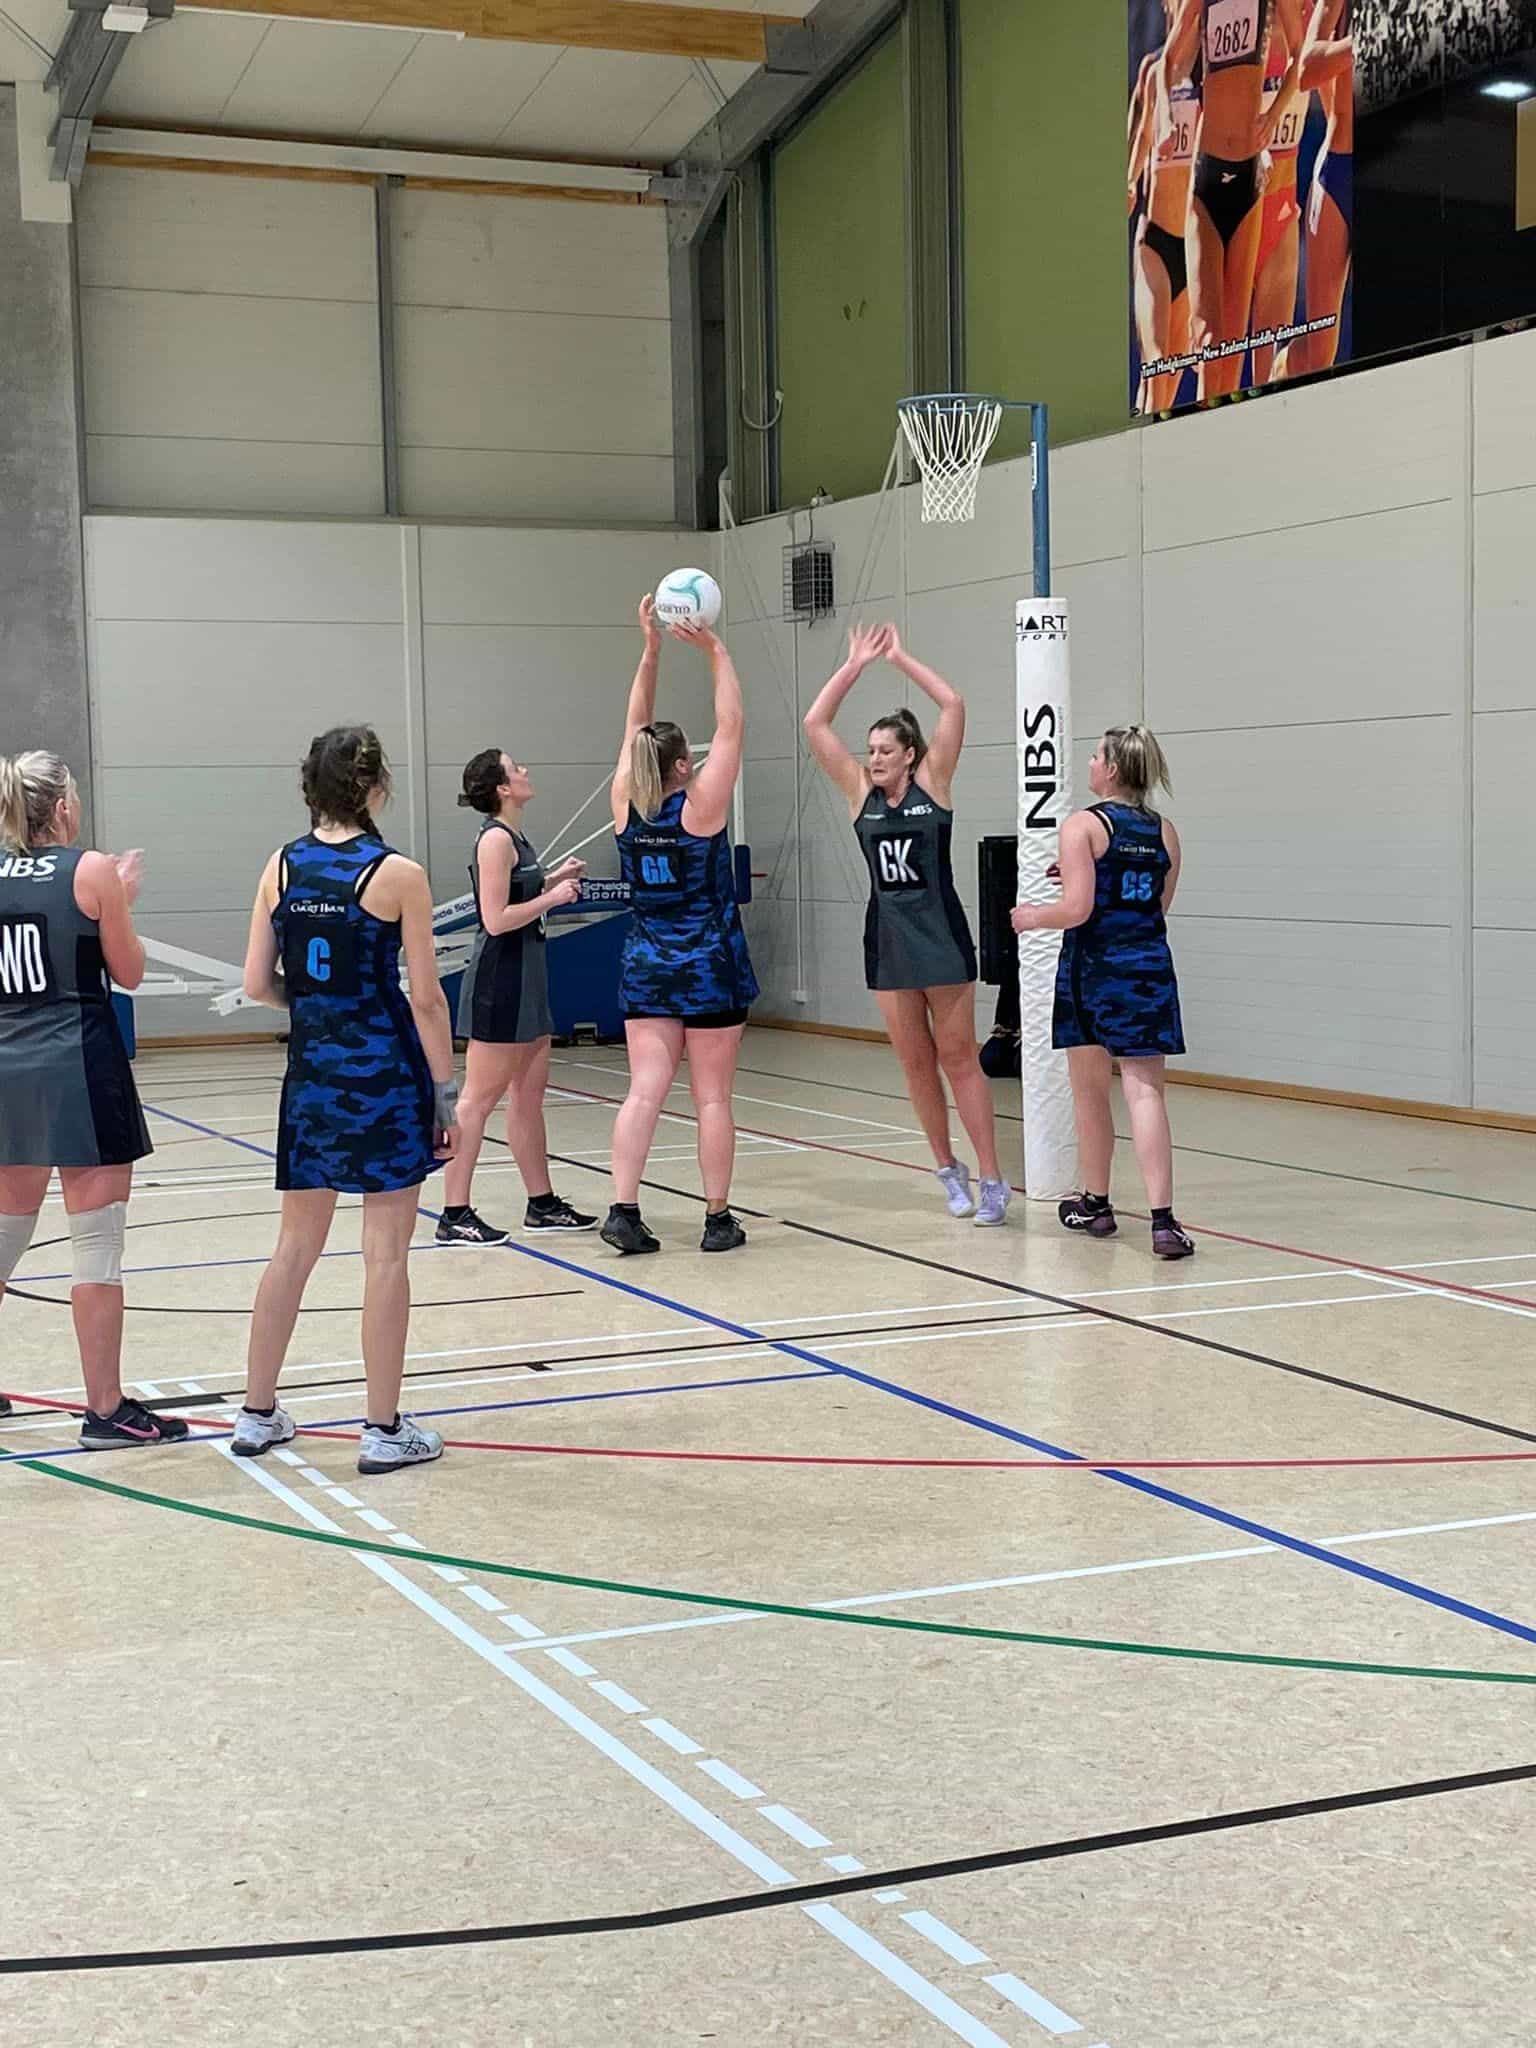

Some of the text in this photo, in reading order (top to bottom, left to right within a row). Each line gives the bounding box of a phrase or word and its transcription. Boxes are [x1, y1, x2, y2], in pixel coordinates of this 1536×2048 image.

[1214, 18, 1250, 57] 2682
[1203, 347, 1220, 361] New
[1220, 338, 1249, 357] Zealand
[1249, 330, 1275, 350] middle
[1276, 324, 1307, 343] distance
[1308, 315, 1336, 332] runner
[1016, 633, 1068, 641] PORT
[1023, 704, 1056, 829] NBS
[641, 855, 677, 884] GA
[878, 838, 919, 883] GK
[1121, 869, 1153, 902] GS
[0, 923, 47, 994] WD
[307, 937, 331, 982] C
